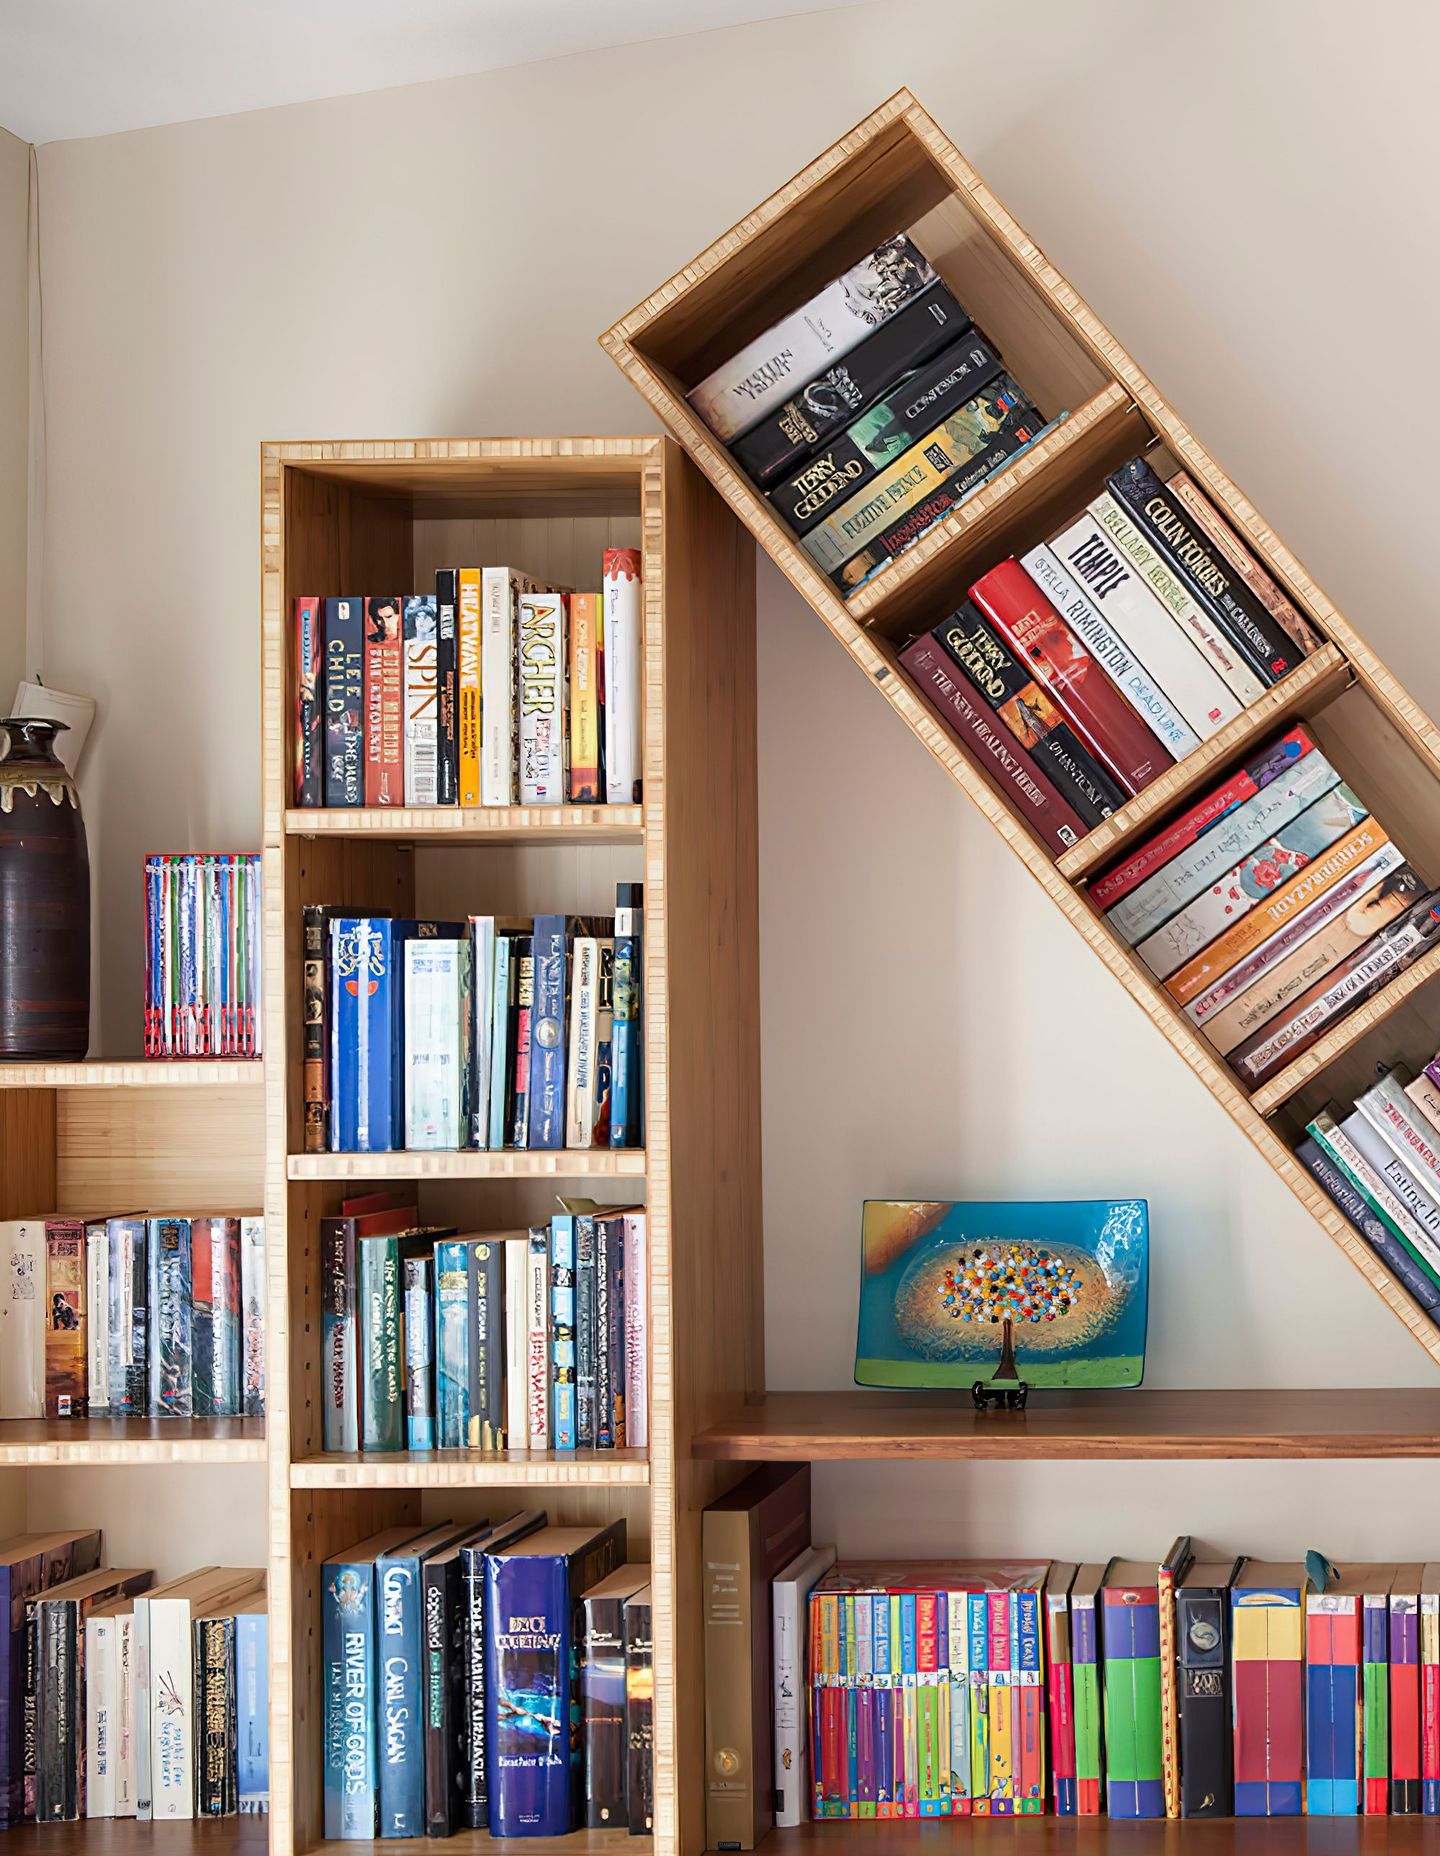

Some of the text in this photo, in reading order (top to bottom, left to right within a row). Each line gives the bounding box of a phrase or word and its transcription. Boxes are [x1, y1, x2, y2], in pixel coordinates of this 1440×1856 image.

[1065, 531, 1131, 601] TEMPLE
[460, 583, 479, 688] HEATWAVE
[522, 602, 556, 717] ARCHER
[1065, 597, 1135, 679] RIMINGTON
[327, 638, 346, 713] CHILD
[345, 652, 362, 699] LEE
[408, 644, 438, 720] SPIN
[343, 1632, 367, 1796] RIVER OF GODS
[385, 1657, 408, 1701] CARL
[386, 1706, 409, 1765] SAGAN
